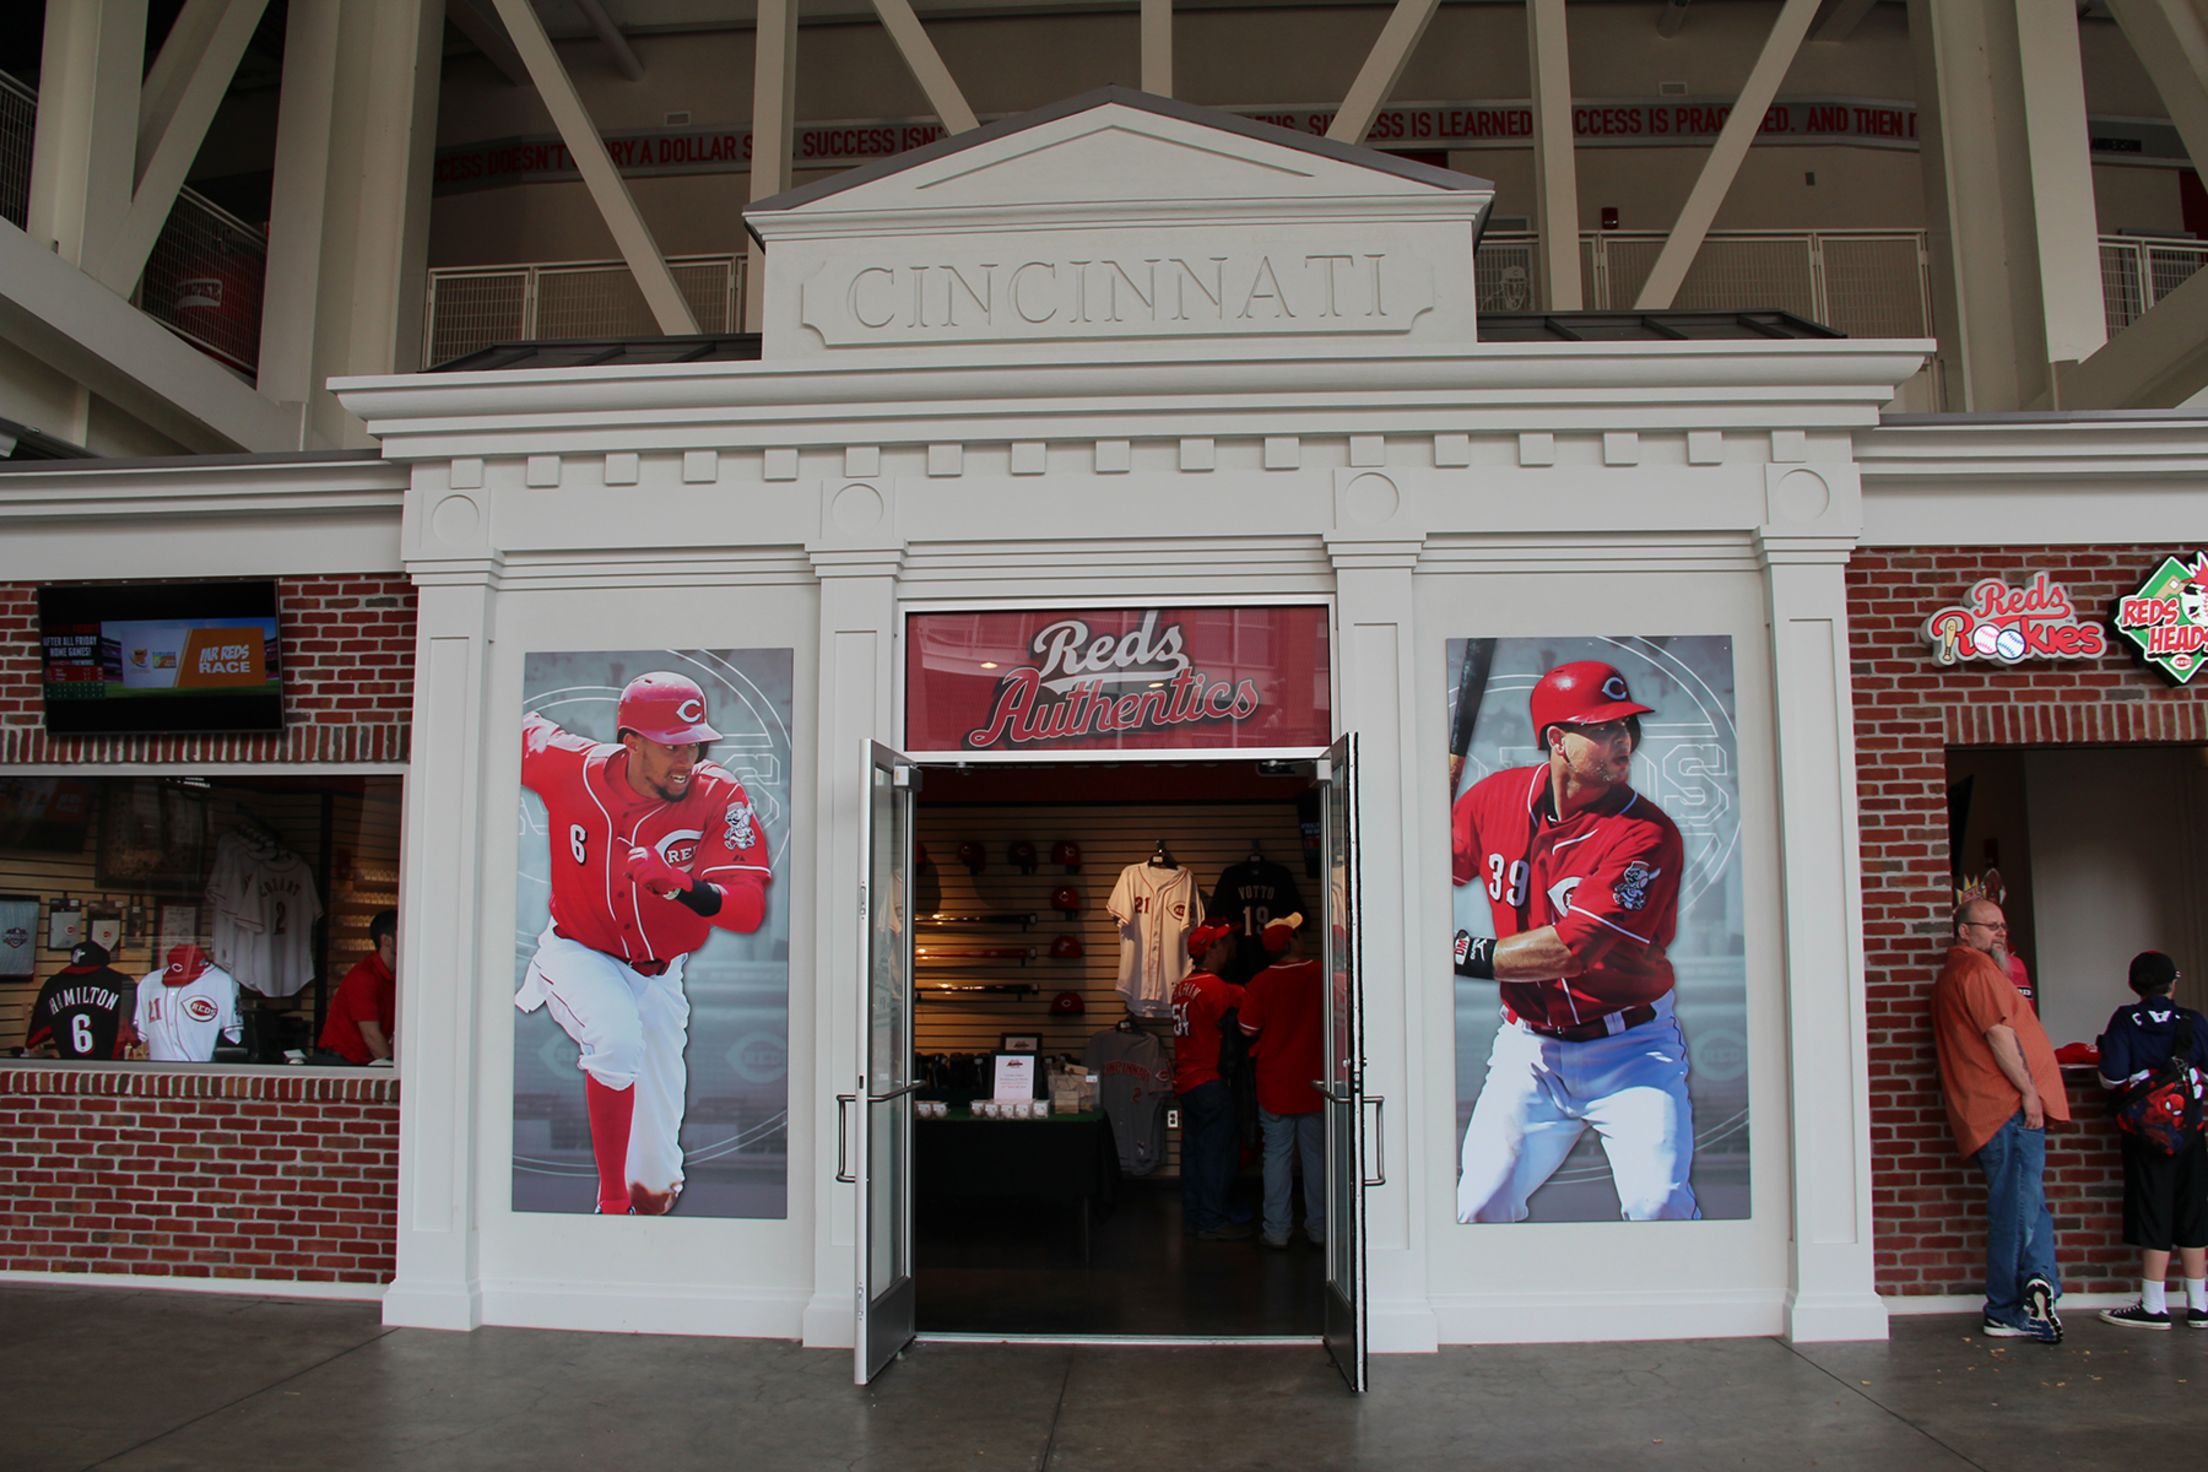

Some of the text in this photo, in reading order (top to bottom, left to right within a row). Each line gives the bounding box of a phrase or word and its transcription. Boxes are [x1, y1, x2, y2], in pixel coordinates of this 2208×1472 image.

[1411, 112, 1431, 137] IS
[1438, 111, 1532, 136] LEARNED
[1650, 109, 1669, 133] IS
[1806, 107, 1849, 132] AND
[1854, 108, 1903, 136] THEN
[487, 144, 566, 175] DOESN'T
[640, 140, 653, 164] A
[659, 136, 736, 163] DOLLAR
[803, 128, 896, 156] SUCCESS
[846, 253, 1388, 328] CINCINNATI
[1972, 574, 2072, 620] Reds
[2121, 598, 2179, 626] REDS
[63, 636, 74, 646] ALL
[75, 634, 98, 646] FRIDAY
[1034, 610, 1188, 676] Reds
[1931, 610, 2103, 660] Rookies
[221, 644, 250, 660] REDS
[199, 661, 251, 673] RACE
[968, 667, 1260, 748] Authentics
[570, 824, 588, 866] 6
[1237, 884, 1276, 900] VOTTO
[1488, 853, 1530, 907] 39
[274, 902, 286, 935] 2
[1134, 896, 1150, 913] 21
[48, 986, 119, 1015] HAMILTON
[148, 998, 161, 1022] 21
[191, 1004, 217, 1017] REDS
[71, 1012, 94, 1054] 6
[1131, 1087, 1142, 1105] 2
